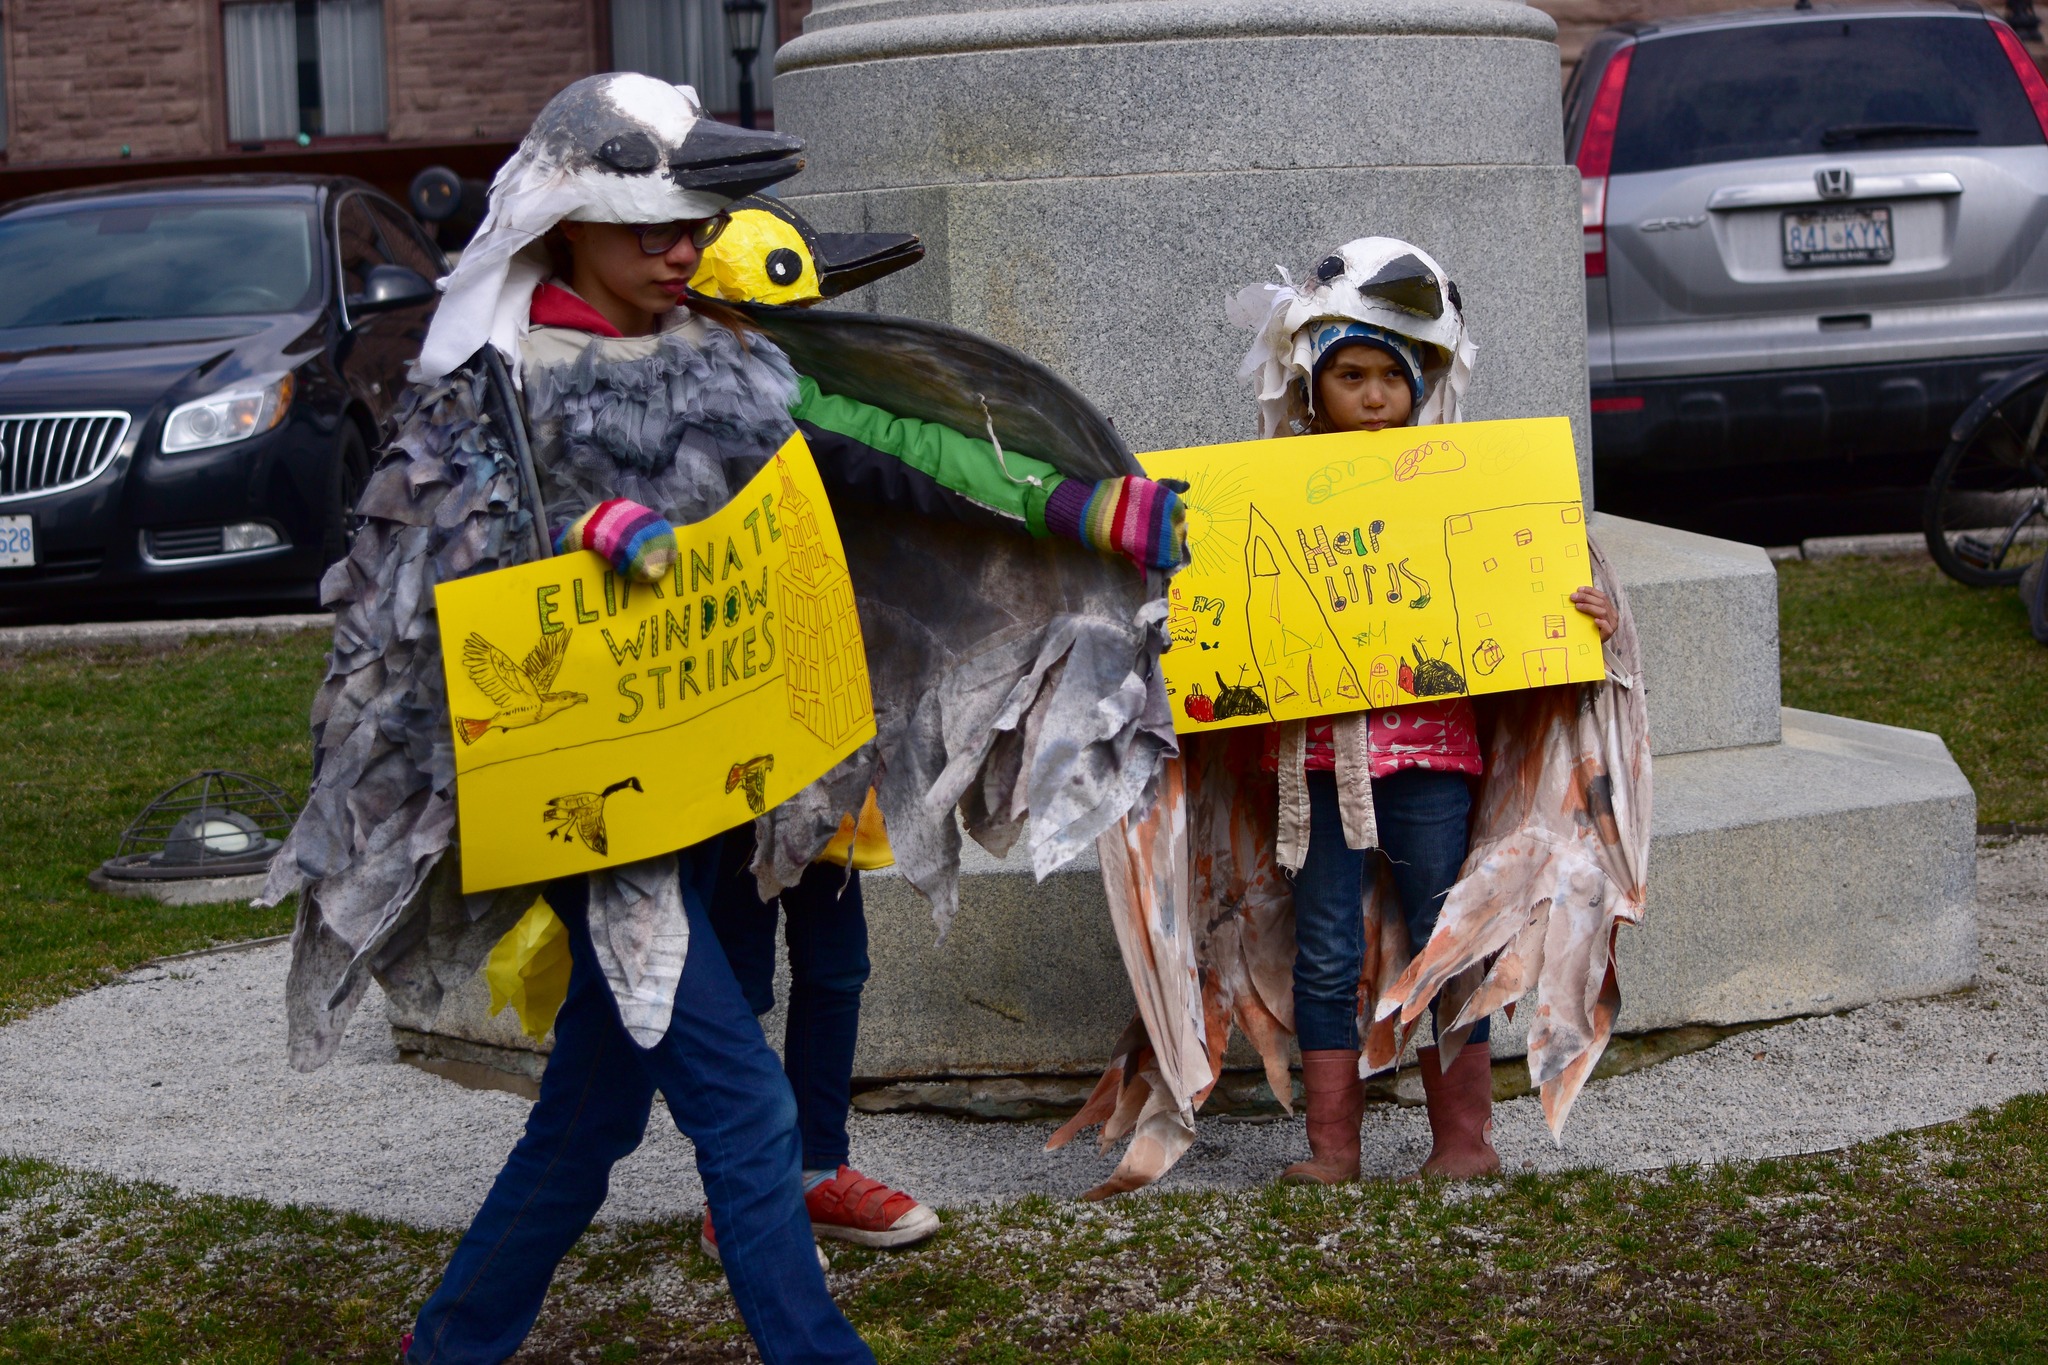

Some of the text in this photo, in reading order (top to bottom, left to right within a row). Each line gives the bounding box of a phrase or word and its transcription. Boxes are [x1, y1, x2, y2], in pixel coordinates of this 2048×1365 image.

[1790, 222, 1887, 253] 841 KYK
[601, 565, 768, 667] WINDOW
[617, 611, 775, 723] STRIKES
